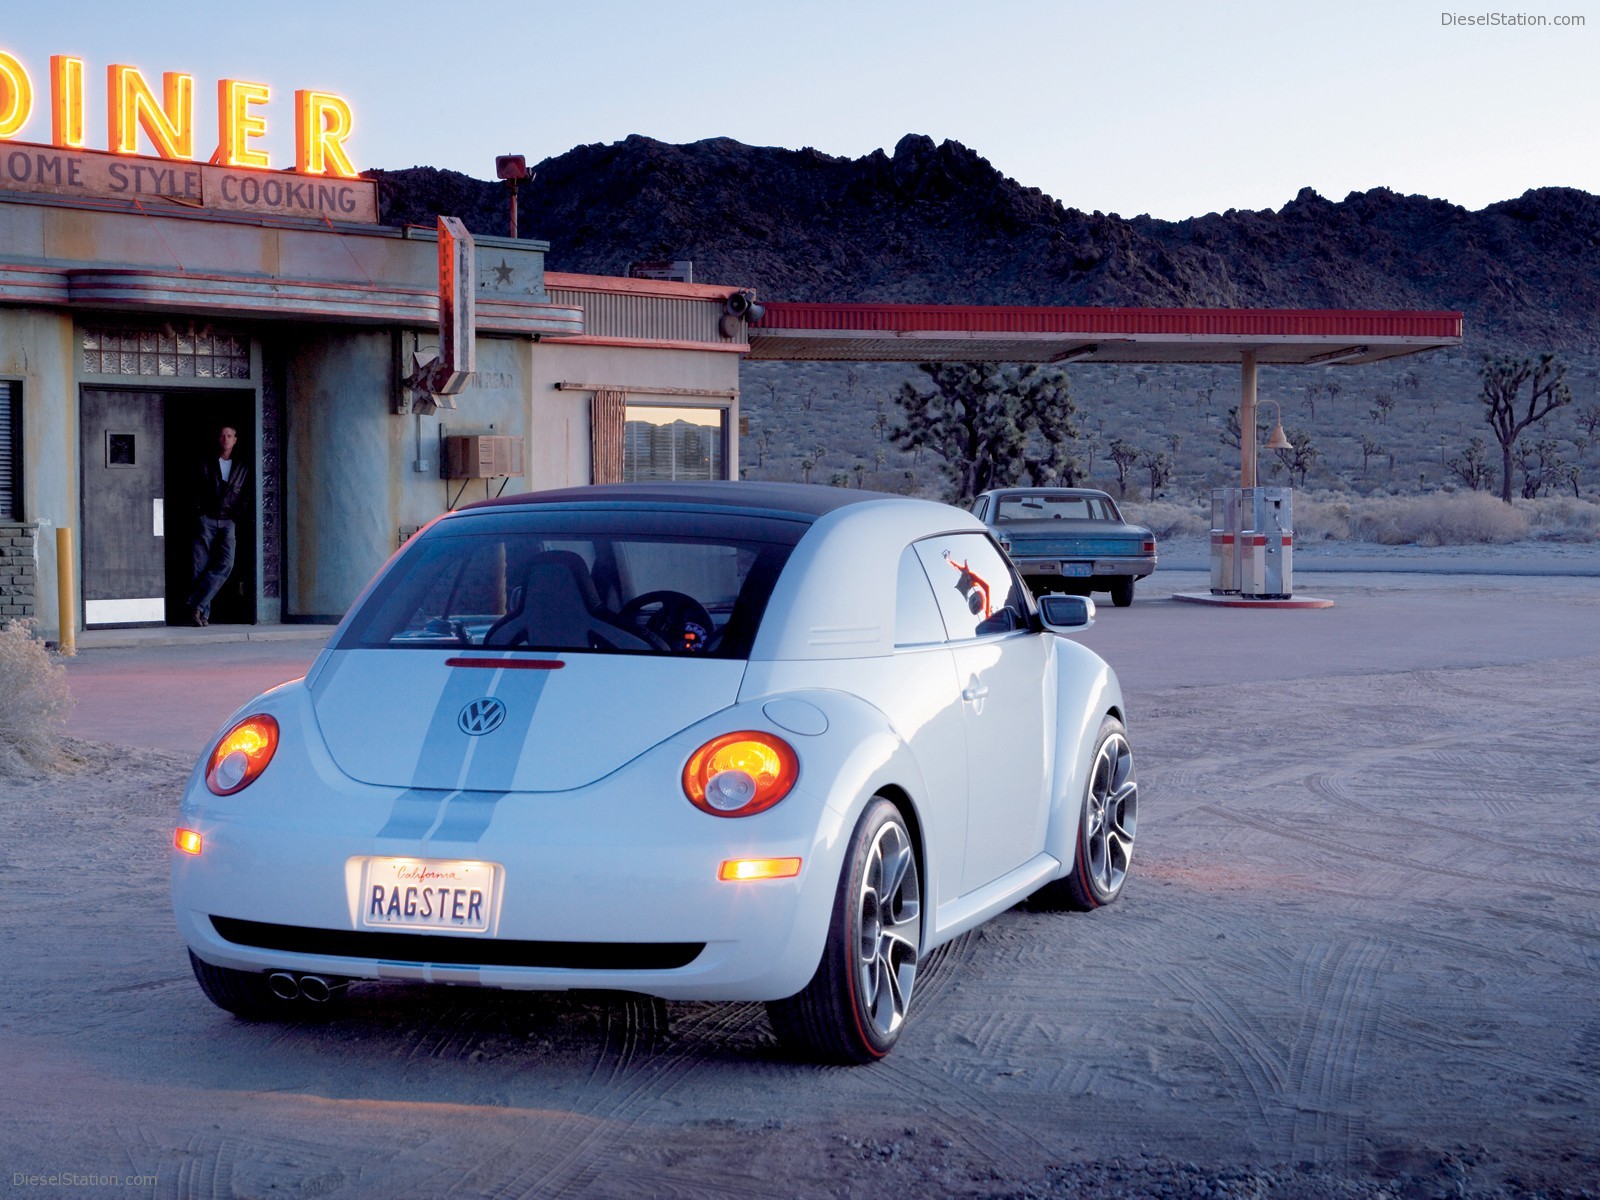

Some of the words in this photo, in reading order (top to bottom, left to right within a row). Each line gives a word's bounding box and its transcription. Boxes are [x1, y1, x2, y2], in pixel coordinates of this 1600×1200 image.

[0, 151, 84, 187] OME
[108, 162, 198, 197] STYLE
[220, 174, 356, 213] COOKING
[458, 697, 506, 736] VW
[397, 865, 462, 883] California
[371, 885, 483, 920] RAGSTER
